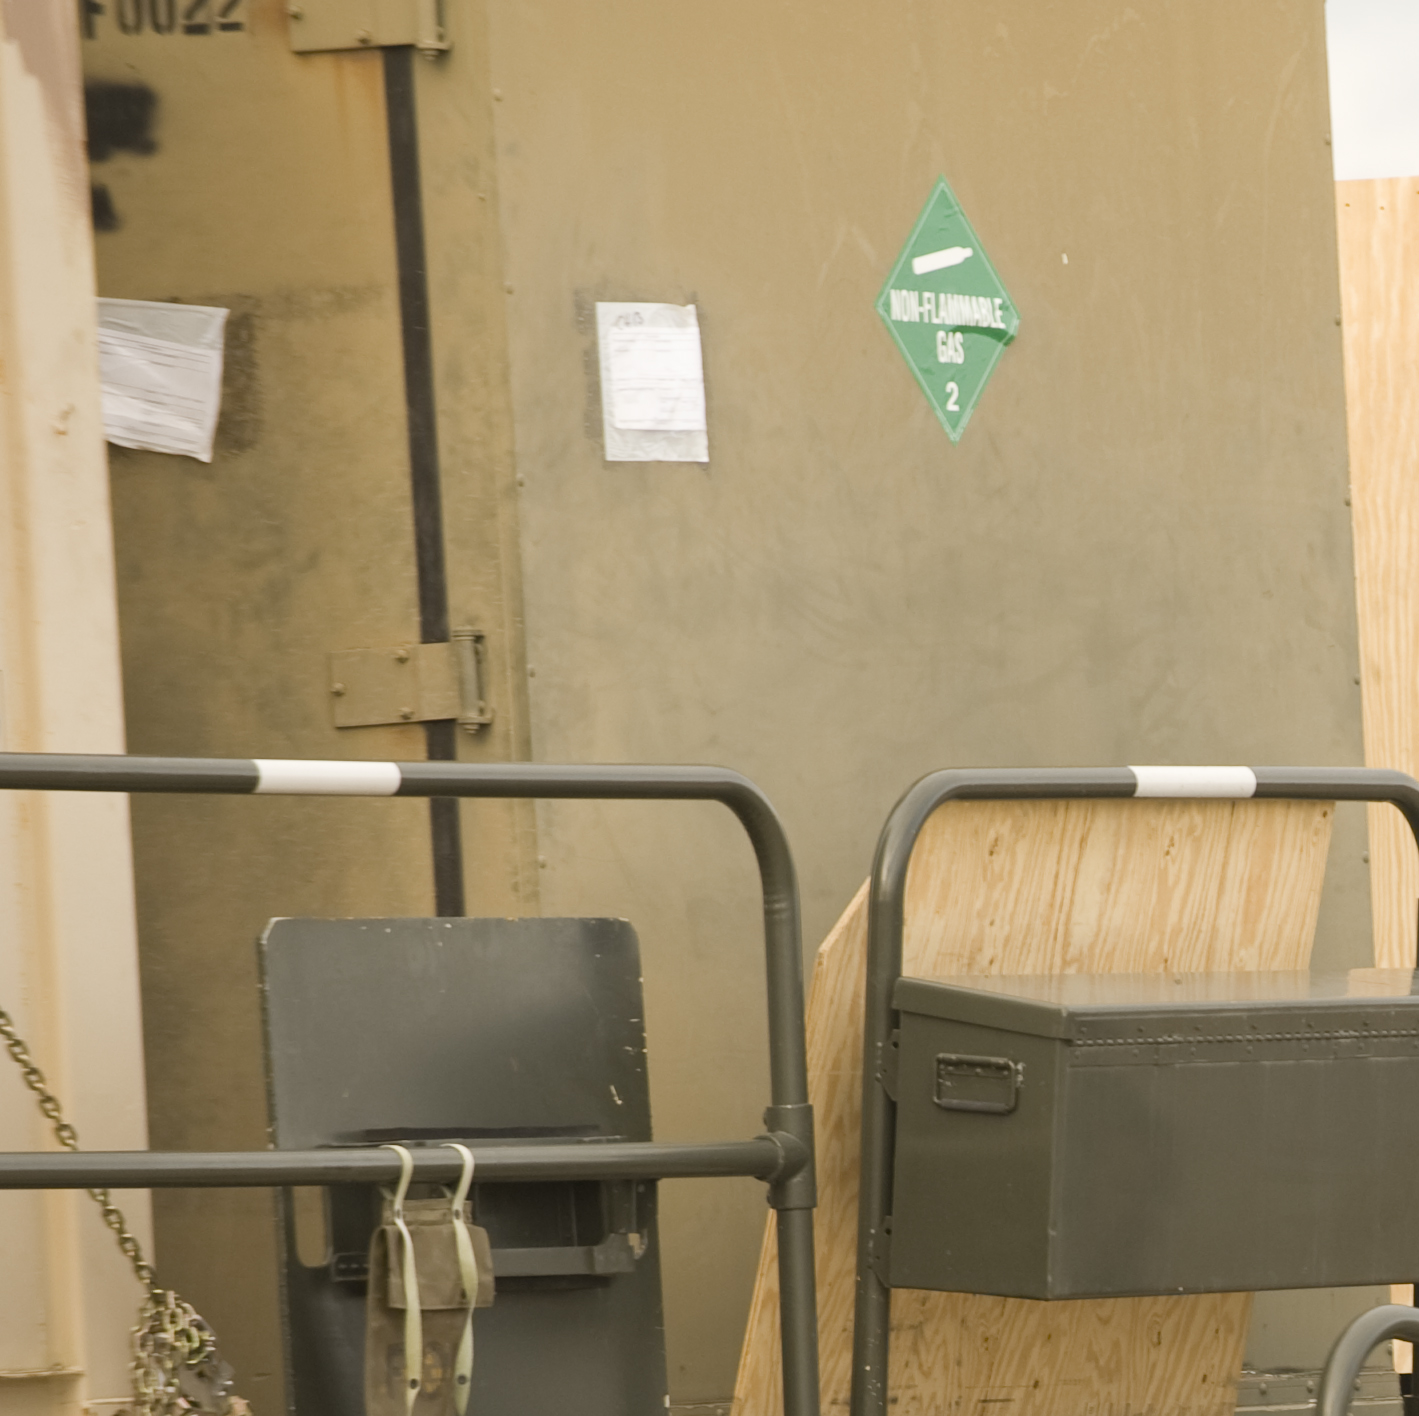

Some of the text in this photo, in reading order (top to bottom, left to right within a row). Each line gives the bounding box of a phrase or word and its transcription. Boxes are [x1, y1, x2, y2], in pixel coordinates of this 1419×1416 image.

[890, 288, 1006, 329] NON-FLAMMABLE
[936, 330, 965, 364] GAS
[945, 381, 960, 411] 2
